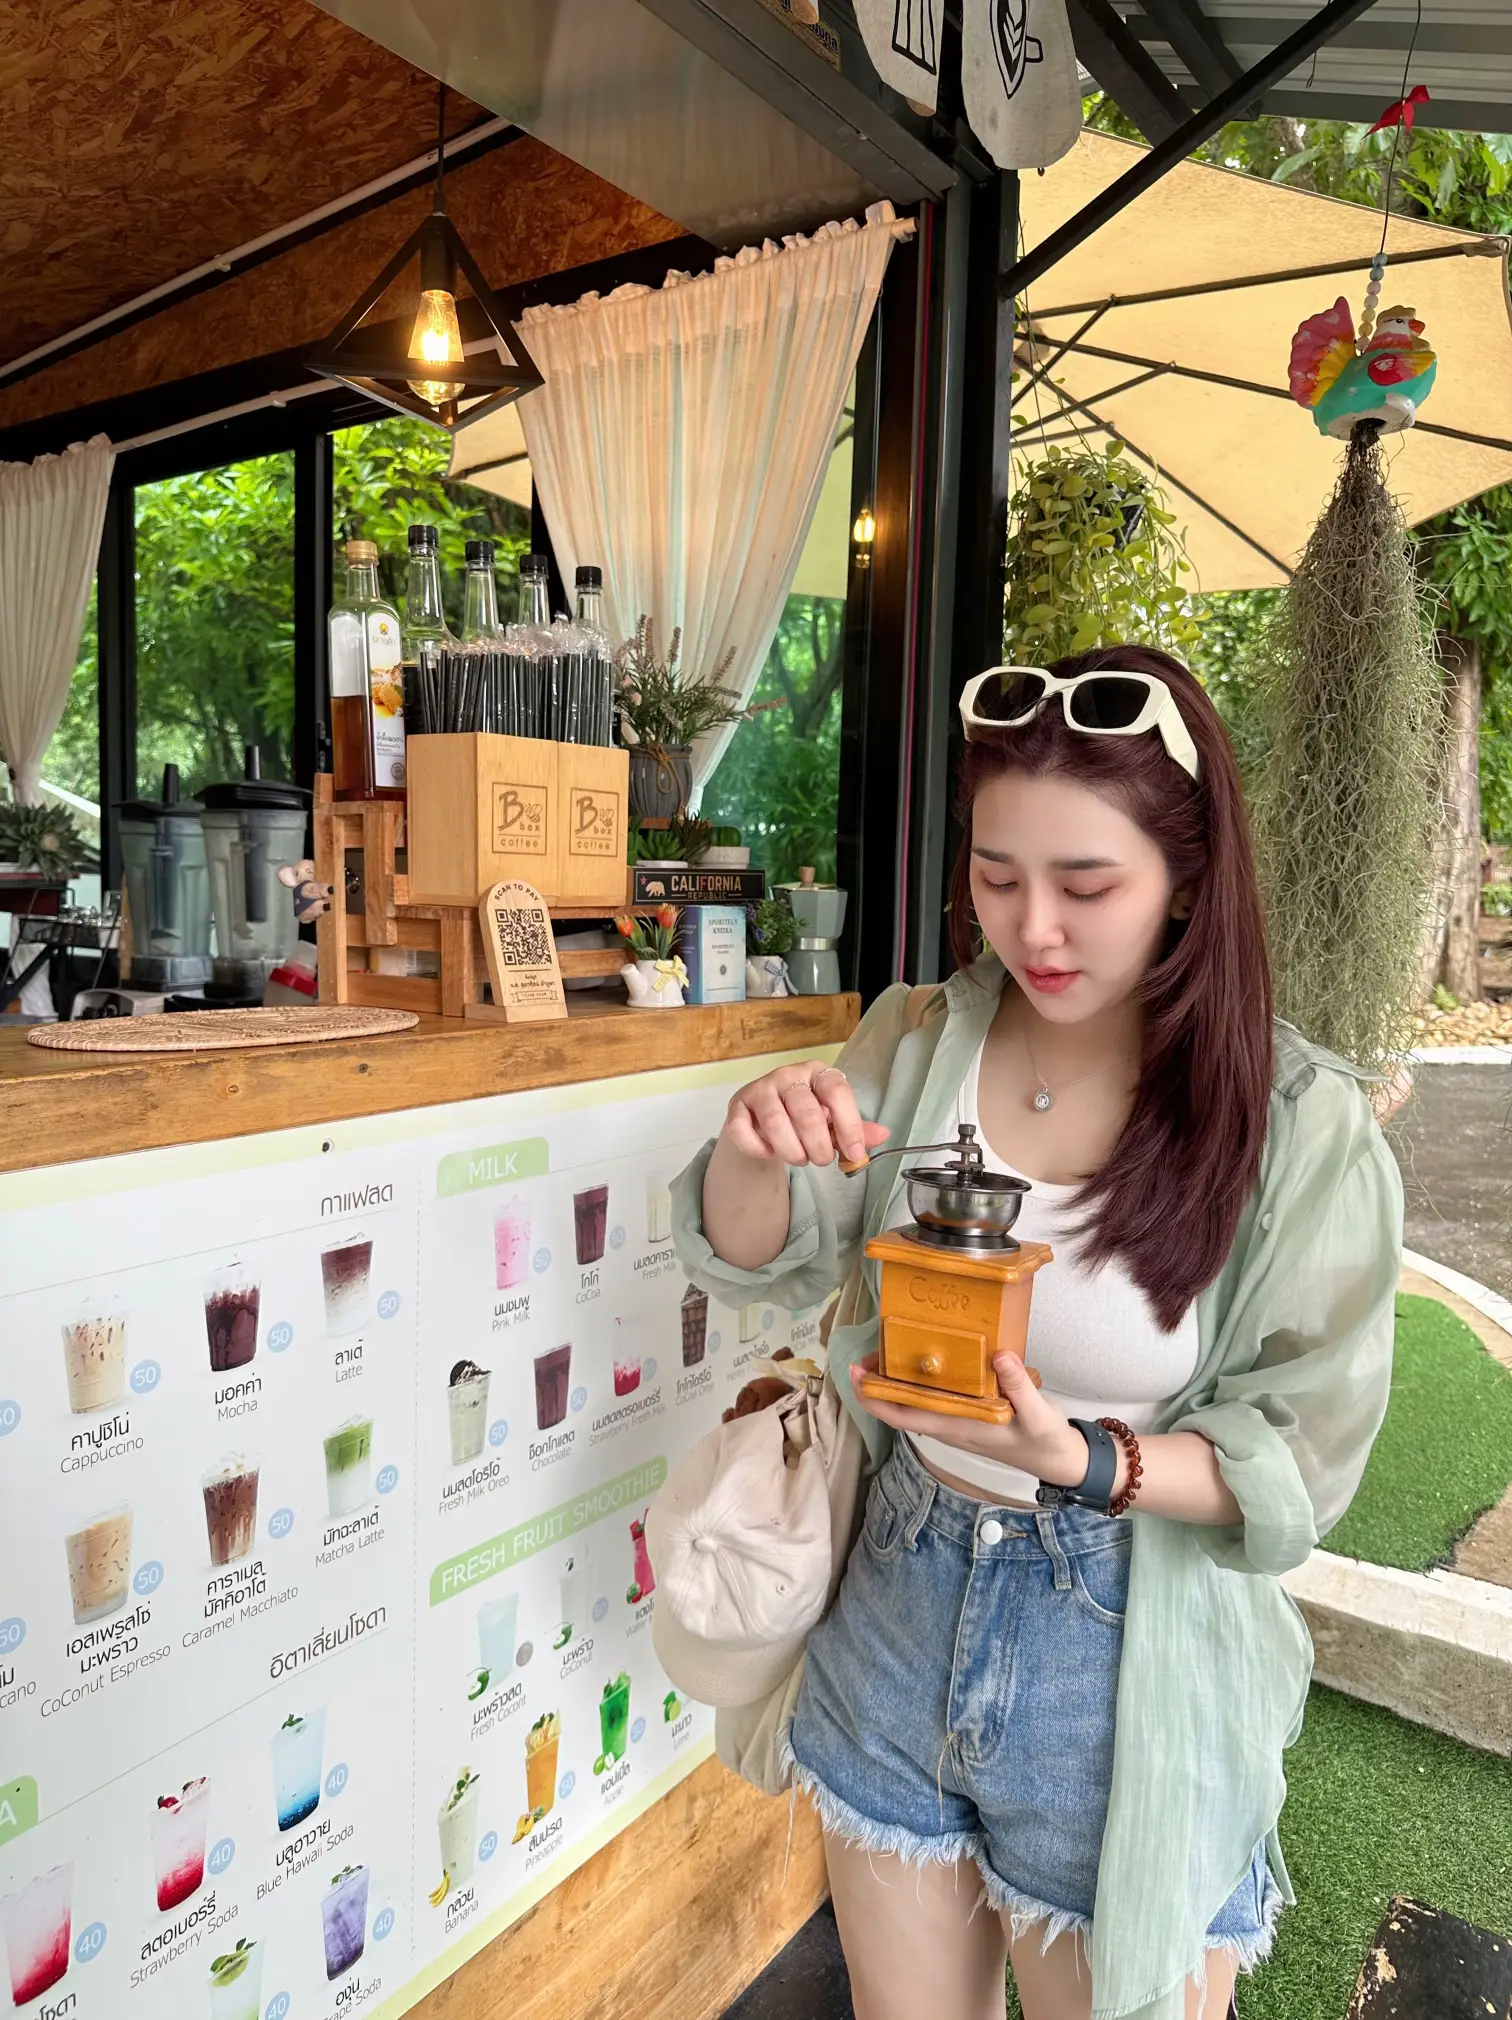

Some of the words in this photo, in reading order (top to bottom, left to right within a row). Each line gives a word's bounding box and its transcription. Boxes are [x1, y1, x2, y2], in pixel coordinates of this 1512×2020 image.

[497, 790, 525, 832] B
[574, 796, 599, 835] B
[519, 822, 541, 832] box
[593, 825, 613, 836] box
[500, 838, 539, 848] coffee
[576, 841, 611, 850] coffee
[494, 884, 511, 901] SCAN
[513, 883, 523, 891] TO
[525, 887, 539, 901] PAY
[671, 875, 742, 891] CALIFORNIA
[687, 891, 727, 900] REPUBLIC
[468, 1152, 518, 1184] MILK
[321, 1184, 393, 1216] กาแฟสด
[381, 1296, 397, 1313] 50
[271, 1328, 291, 1347] 50
[335, 1338, 363, 1366] ลาเต้
[135, 1366, 157, 1387] 50
[335, 1364, 364, 1383] Latte
[214, 1371, 263, 1406] มอคค่า
[217, 1399, 259, 1422] Mocha
[71, 1411, 130, 1452] คาปูชิโน่
[491, 1427, 506, 1444] 50
[60, 1436, 145, 1474] Cappuccino
[531, 1446, 573, 1472] Chocolate
[379, 1470, 395, 1488] 50
[438, 1494, 465, 1515] Fresh
[466, 1485, 486, 1507] Milk
[488, 1475, 511, 1493] Oreo
[271, 1513, 290, 1534] 50
[441, 1542, 506, 1594] FRESH
[513, 1511, 567, 1558] FRUIT
[572, 1464, 661, 1526] SMOOTHIE
[315, 1541, 356, 1568] Matcha
[358, 1527, 386, 1550] Latte
[137, 1567, 160, 1590] 50
[207, 1560, 264, 1596] คาราเมล
[204, 1572, 268, 1619] มัคคิอาโต้
[182, 1611, 236, 1648] Caramel
[240, 1585, 300, 1623] Macchiato
[80, 1634, 139, 1674] มะพร้าว
[270, 1606, 387, 1680] อิตาเลี่ยนโซดา
[40, 1674, 105, 1718] CoConut
[110, 1645, 172, 1683] Espresso
[327, 1769, 345, 1790] 40
[211, 1844, 231, 1867] 40
[276, 1818, 331, 1867] บลูฮาวาย
[480, 1838, 495, 1857] 50
[256, 1874, 283, 1901] Blue
[286, 1842, 323, 1881] Hawaii
[326, 1823, 354, 1852] Soda
[445, 1899, 479, 1934] Banana
[447, 1887, 475, 1918] กล้วย
[376, 1911, 392, 1931] 40
[78, 1928, 102, 1955] 40
[129, 1928, 203, 1990] Strawberry
[207, 1904, 239, 1936] Soda
[335, 1976, 361, 2007] องุ่น
[355, 1976, 383, 2007] Soda
